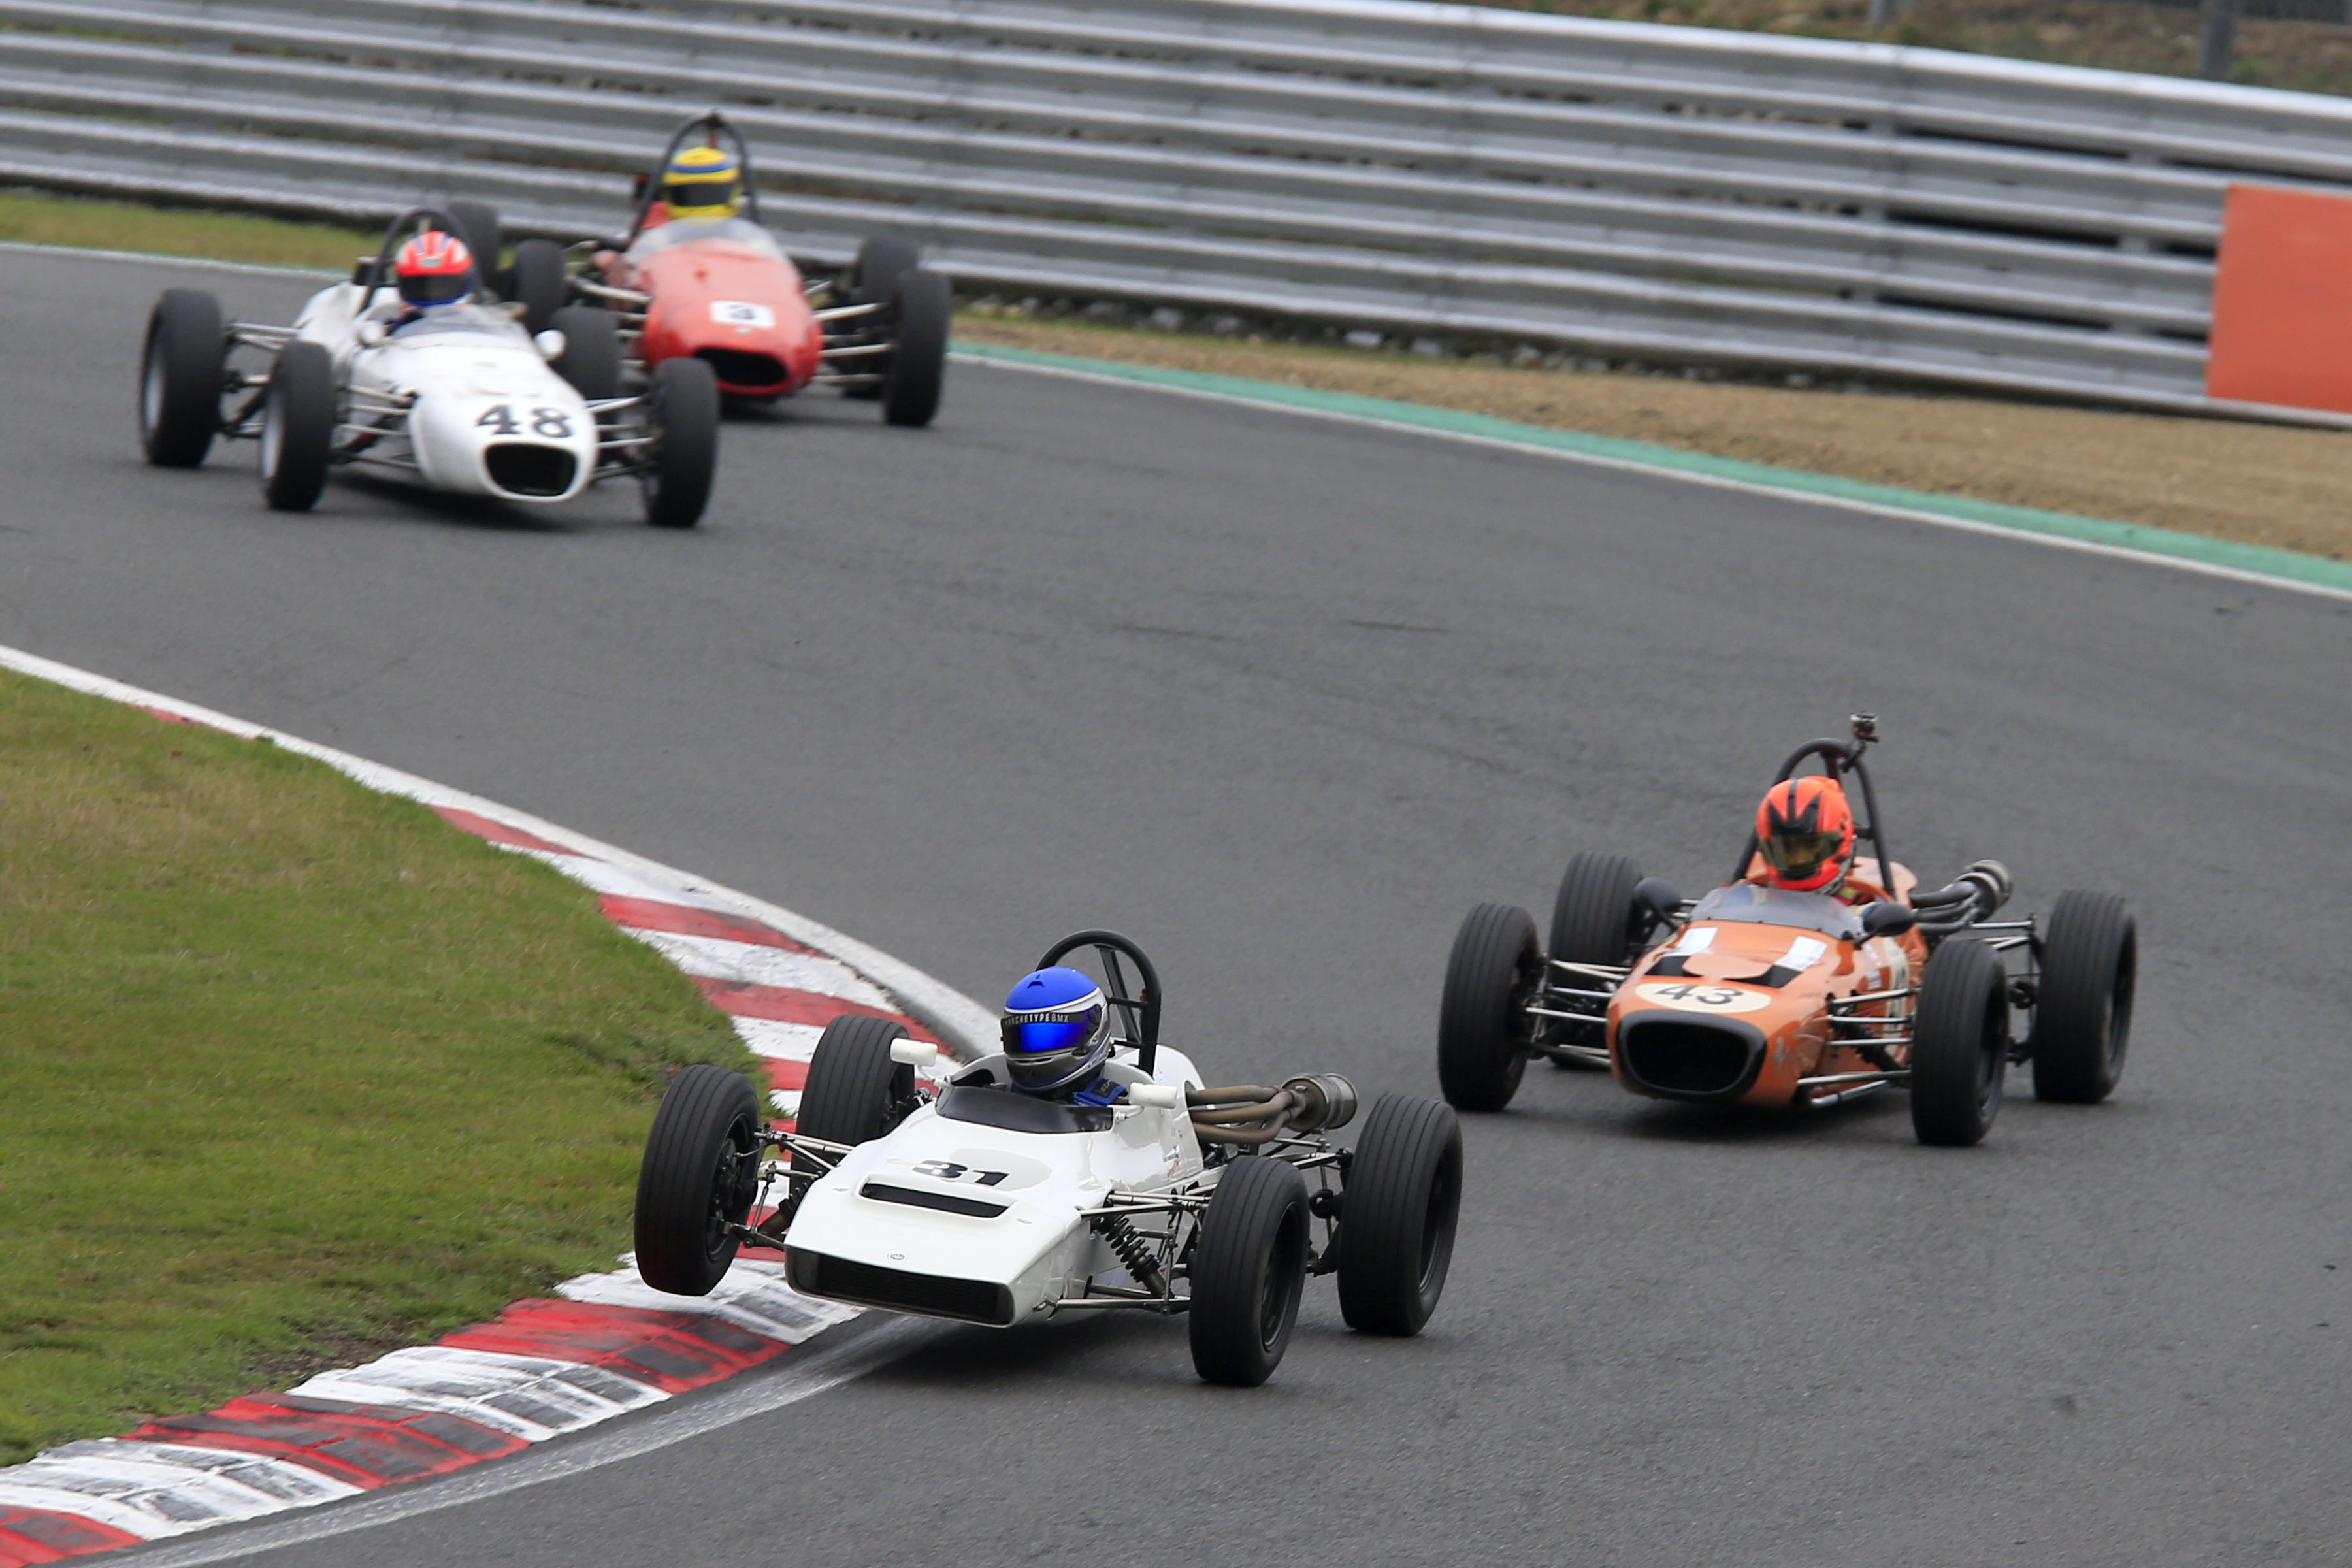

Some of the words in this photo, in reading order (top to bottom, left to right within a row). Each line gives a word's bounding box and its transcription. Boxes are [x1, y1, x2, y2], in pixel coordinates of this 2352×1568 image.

[474, 404, 574, 438] 48
[1655, 984, 1744, 1005] 43
[912, 1159, 1010, 1186] 31
